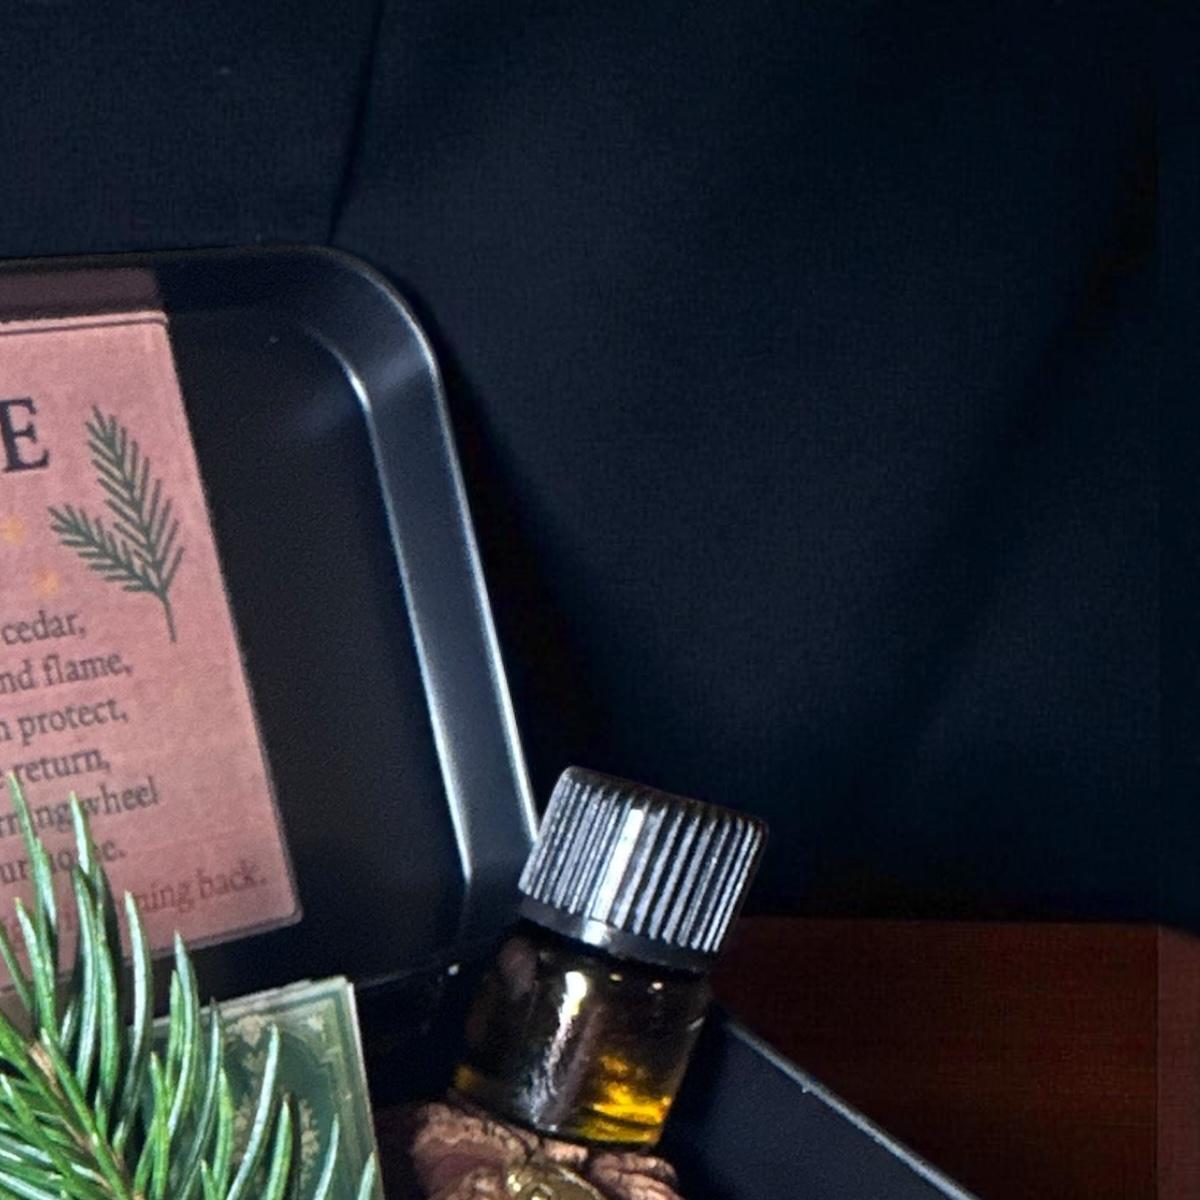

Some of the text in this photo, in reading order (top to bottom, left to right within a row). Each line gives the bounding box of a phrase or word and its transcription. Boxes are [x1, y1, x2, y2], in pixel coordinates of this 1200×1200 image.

[1, 608, 86, 646] cedar,
[43, 651, 133, 689] flame,
[17, 697, 129, 746] protect,
[13, 749, 111, 783] return,
